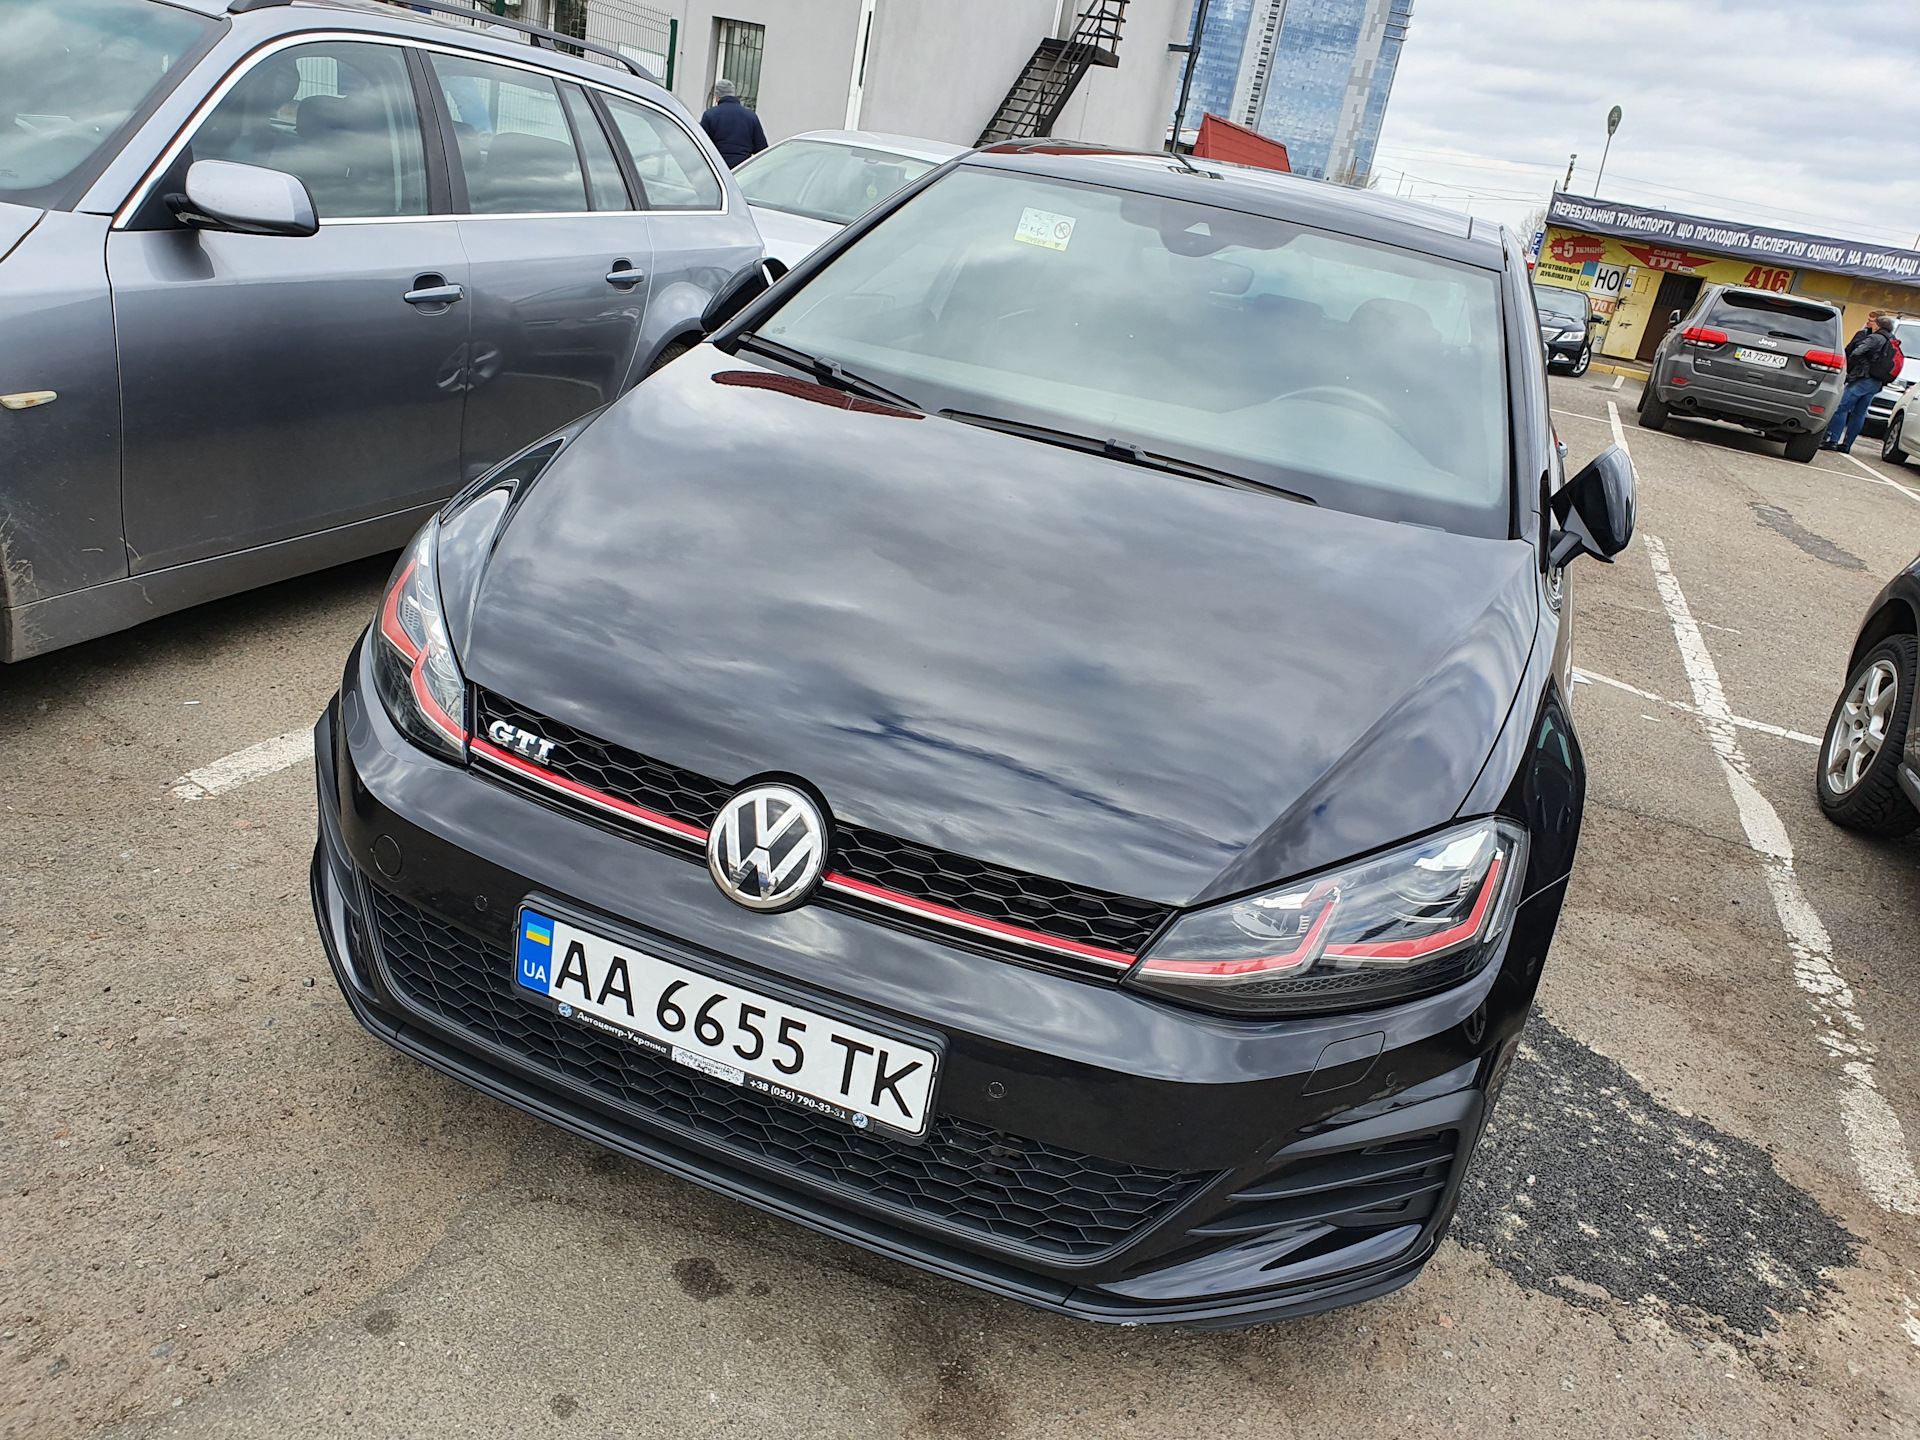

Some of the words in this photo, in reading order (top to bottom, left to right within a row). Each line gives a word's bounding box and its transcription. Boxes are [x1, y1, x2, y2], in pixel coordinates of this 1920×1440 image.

[1552, 201, 1615, 225] ПЕРЕБУВАННЯ
[1617, 212, 1676, 237] ТРАНСПОРТУ,
[1676, 222, 1694, 239] ЩО
[1693, 226, 1750, 248] ПРОХОДИТЬ
[1751, 235, 1808, 257] ЕКСПЕРТНУ
[1807, 243, 1846, 266] ОЦІНКУ,
[1846, 250, 1862, 265] НА
[1861, 252, 1919, 276] ПЛОЩАДЦІ
[1563, 241, 1575, 258] 5
[1648, 255, 1684, 271] ТУТ
[1653, 248, 1682, 259] САМЕ
[1580, 279, 1590, 287] UA
[1594, 267, 1626, 293] НО
[1743, 266, 1791, 293] 416
[1758, 338, 1778, 348] Jeep
[1740, 350, 1752, 359] AA
[1753, 352, 1773, 363] 7227
[488, 720, 557, 766] GTI
[522, 958, 548, 984] UA
[554, 939, 636, 1018] AA
[656, 979, 807, 1076] 6655
[830, 1032, 924, 1120] TK
[749, 1079, 769, 1092] +38
[770, 1083, 795, 1103] (056)
